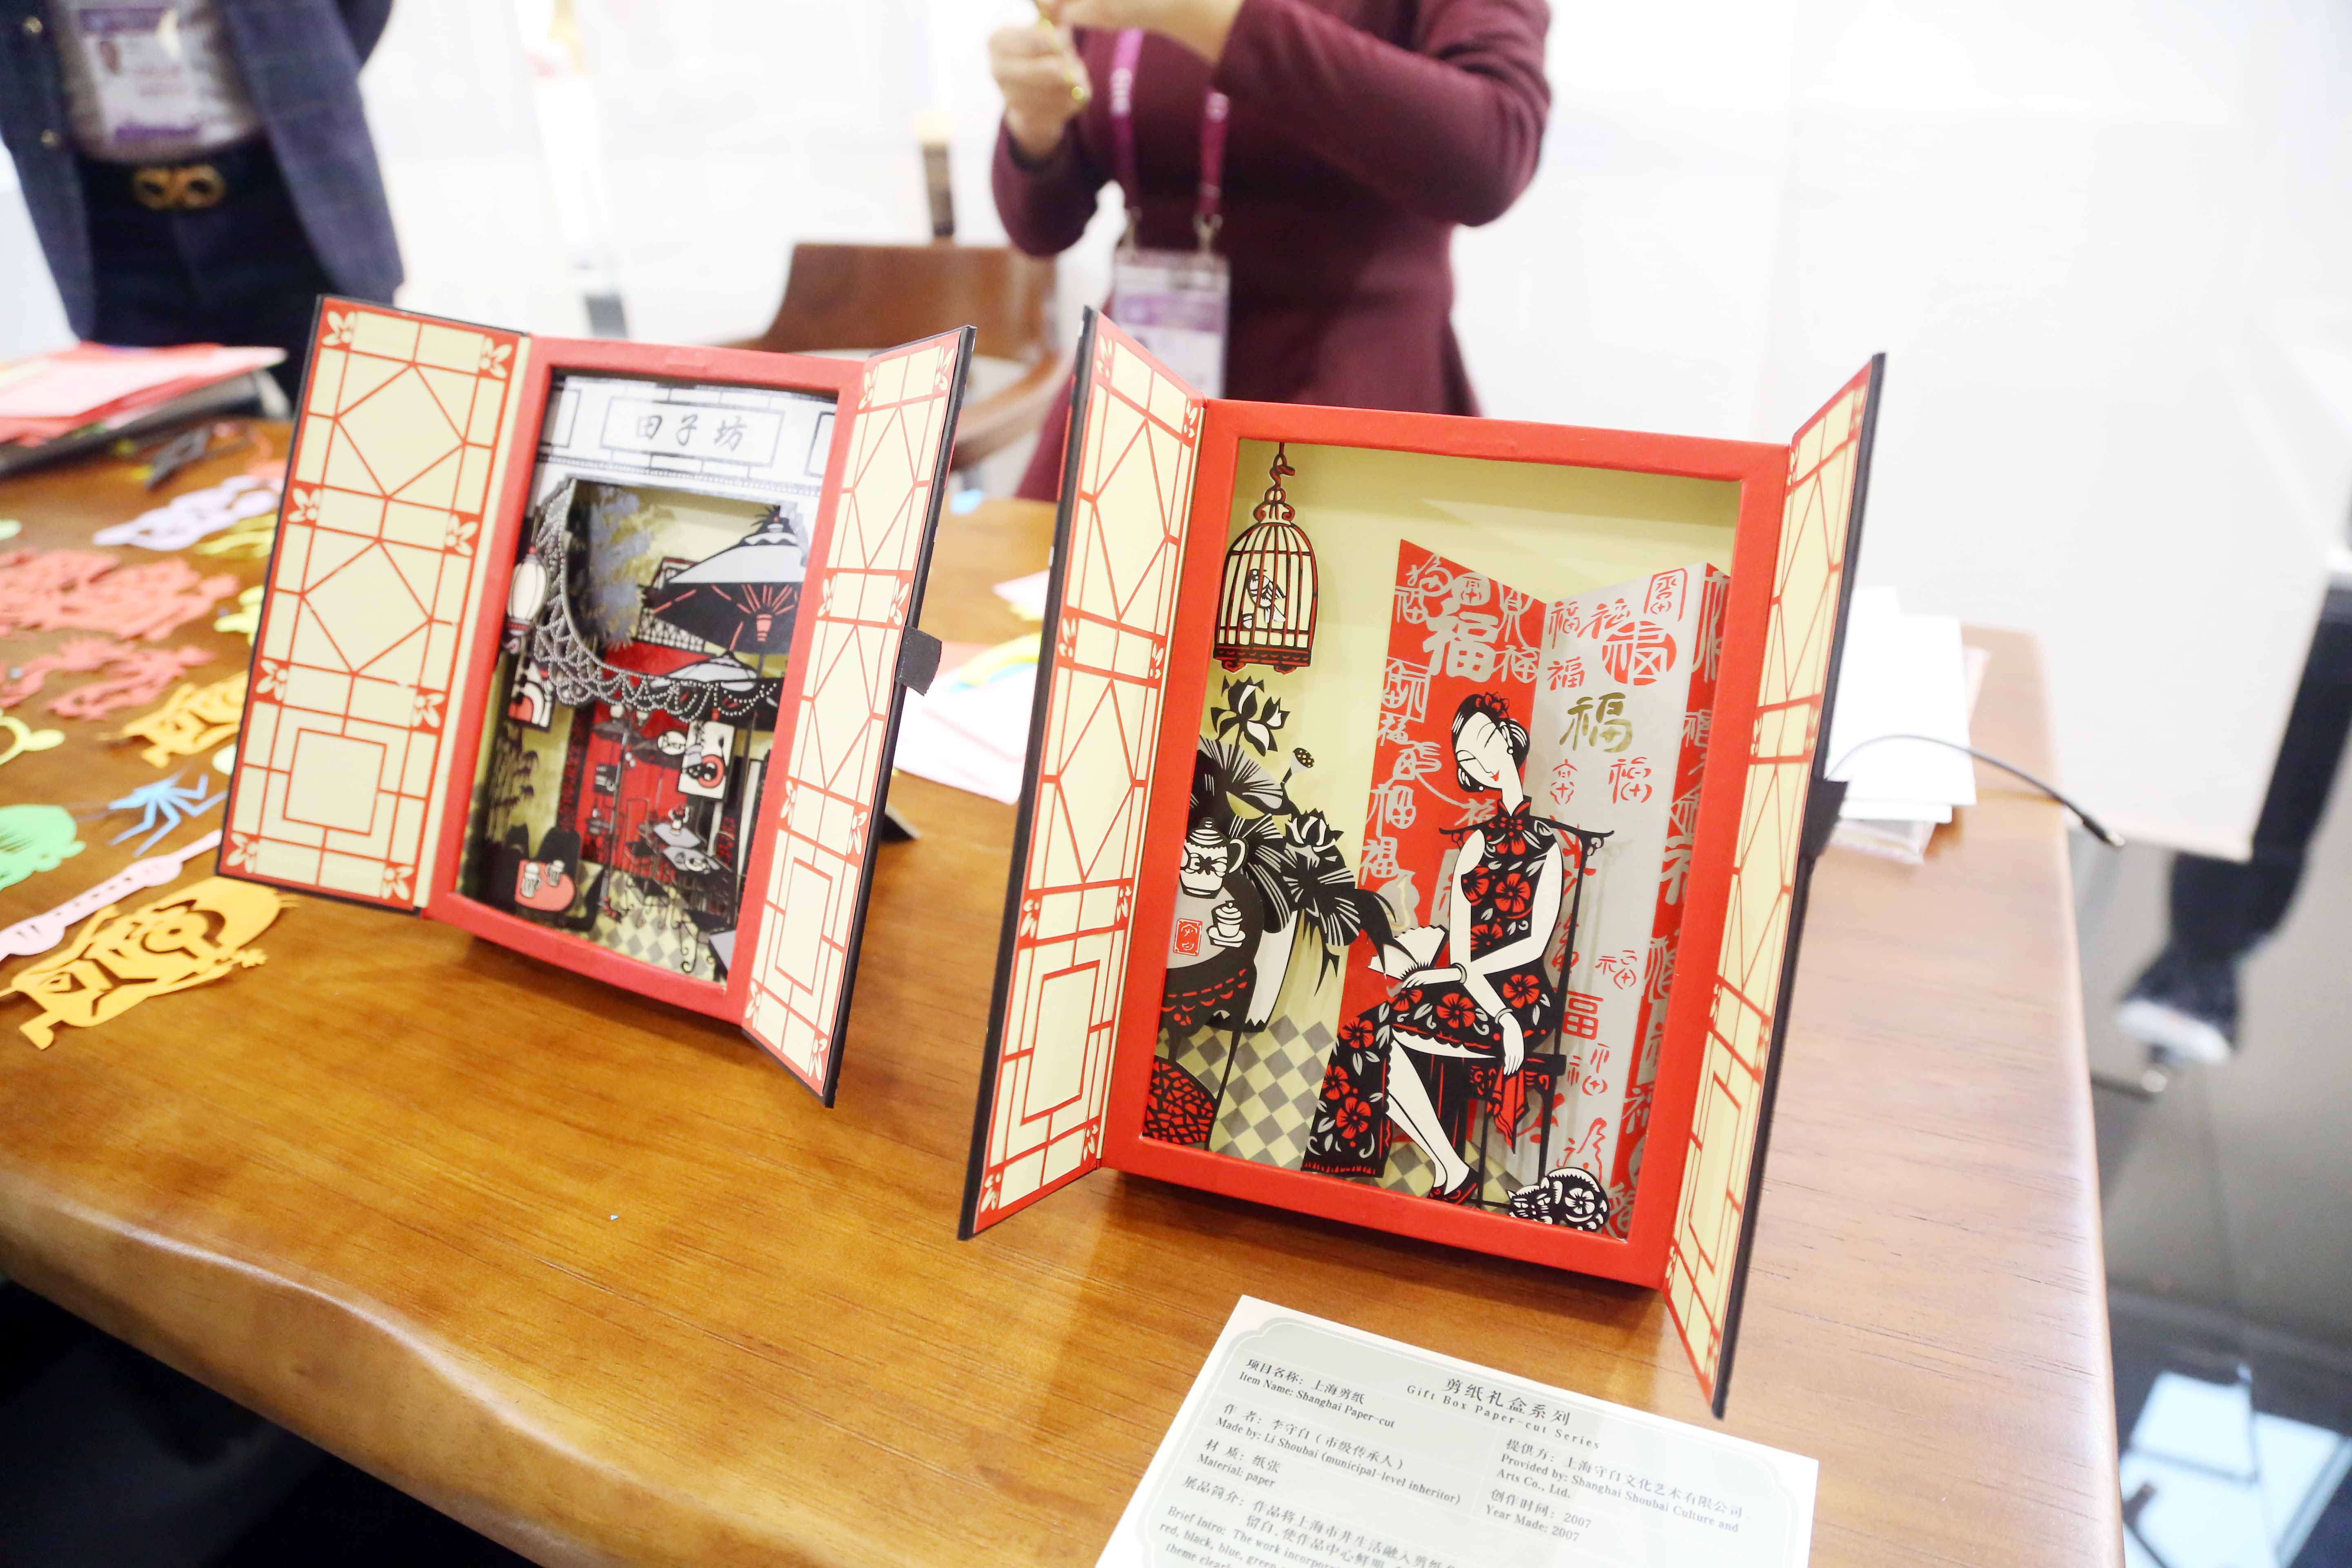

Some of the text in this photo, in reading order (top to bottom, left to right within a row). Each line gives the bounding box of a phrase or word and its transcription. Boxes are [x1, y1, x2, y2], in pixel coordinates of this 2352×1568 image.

[635, 414, 748, 452] 田子坊
[1546, 656, 1586, 690] 福
[1560, 692, 1633, 753] 福
[1239, 1372, 1395, 1428] Item Name: Shanghai Paper-cut
[1407, 1384, 1601, 1449] Gift Box Paper-cut Series
[1442, 1378, 1571, 1426] 剪纸礼盒系列
[1197, 1453, 1276, 1488] Material: paper
[1216, 1417, 1461, 1506] Made by: Li Shoubai (municipal-level inheritor)
[1497, 1468, 1571, 1499] Arts Co., Ltd.
[1501, 1453, 1739, 1533] Provided by: Shanghai Shoubai Culture and
[1159, 1523, 1179, 1537] red,
[1183, 1530, 1214, 1550] black,
[1218, 1543, 1242, 1560] blue,
[1168, 1506, 1196, 1522] Brief
[1197, 1517, 1225, 1535] Intro:
[1233, 1529, 1252, 1544] The
[1256, 1540, 1281, 1553] work
[1486, 1504, 1580, 1542] Year Made: 2007
[1166, 1544, 1196, 1561] theme
